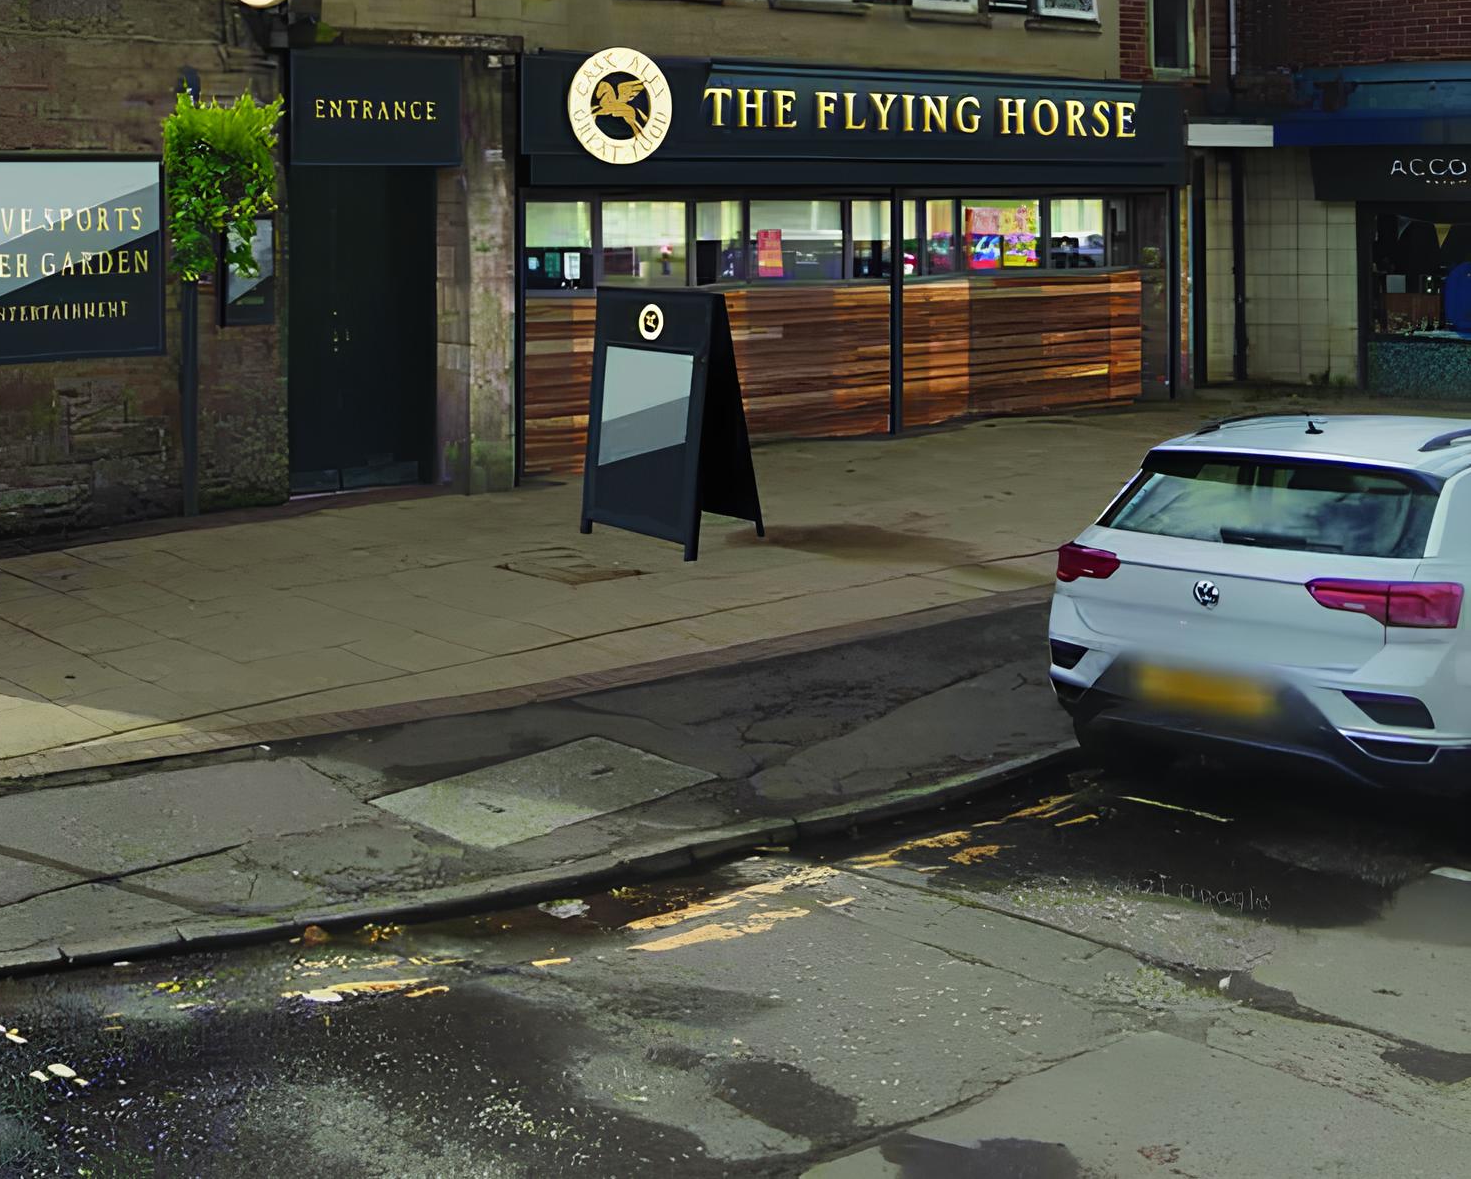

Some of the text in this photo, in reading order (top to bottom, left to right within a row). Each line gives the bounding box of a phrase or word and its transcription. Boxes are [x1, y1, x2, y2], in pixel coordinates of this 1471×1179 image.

[315, 99, 437, 121] ENTRANCE
[703, 87, 1136, 138] THE FLYING HORSE
[42, 206, 143, 232] SPORTS
[41, 249, 149, 276] GARDEN
